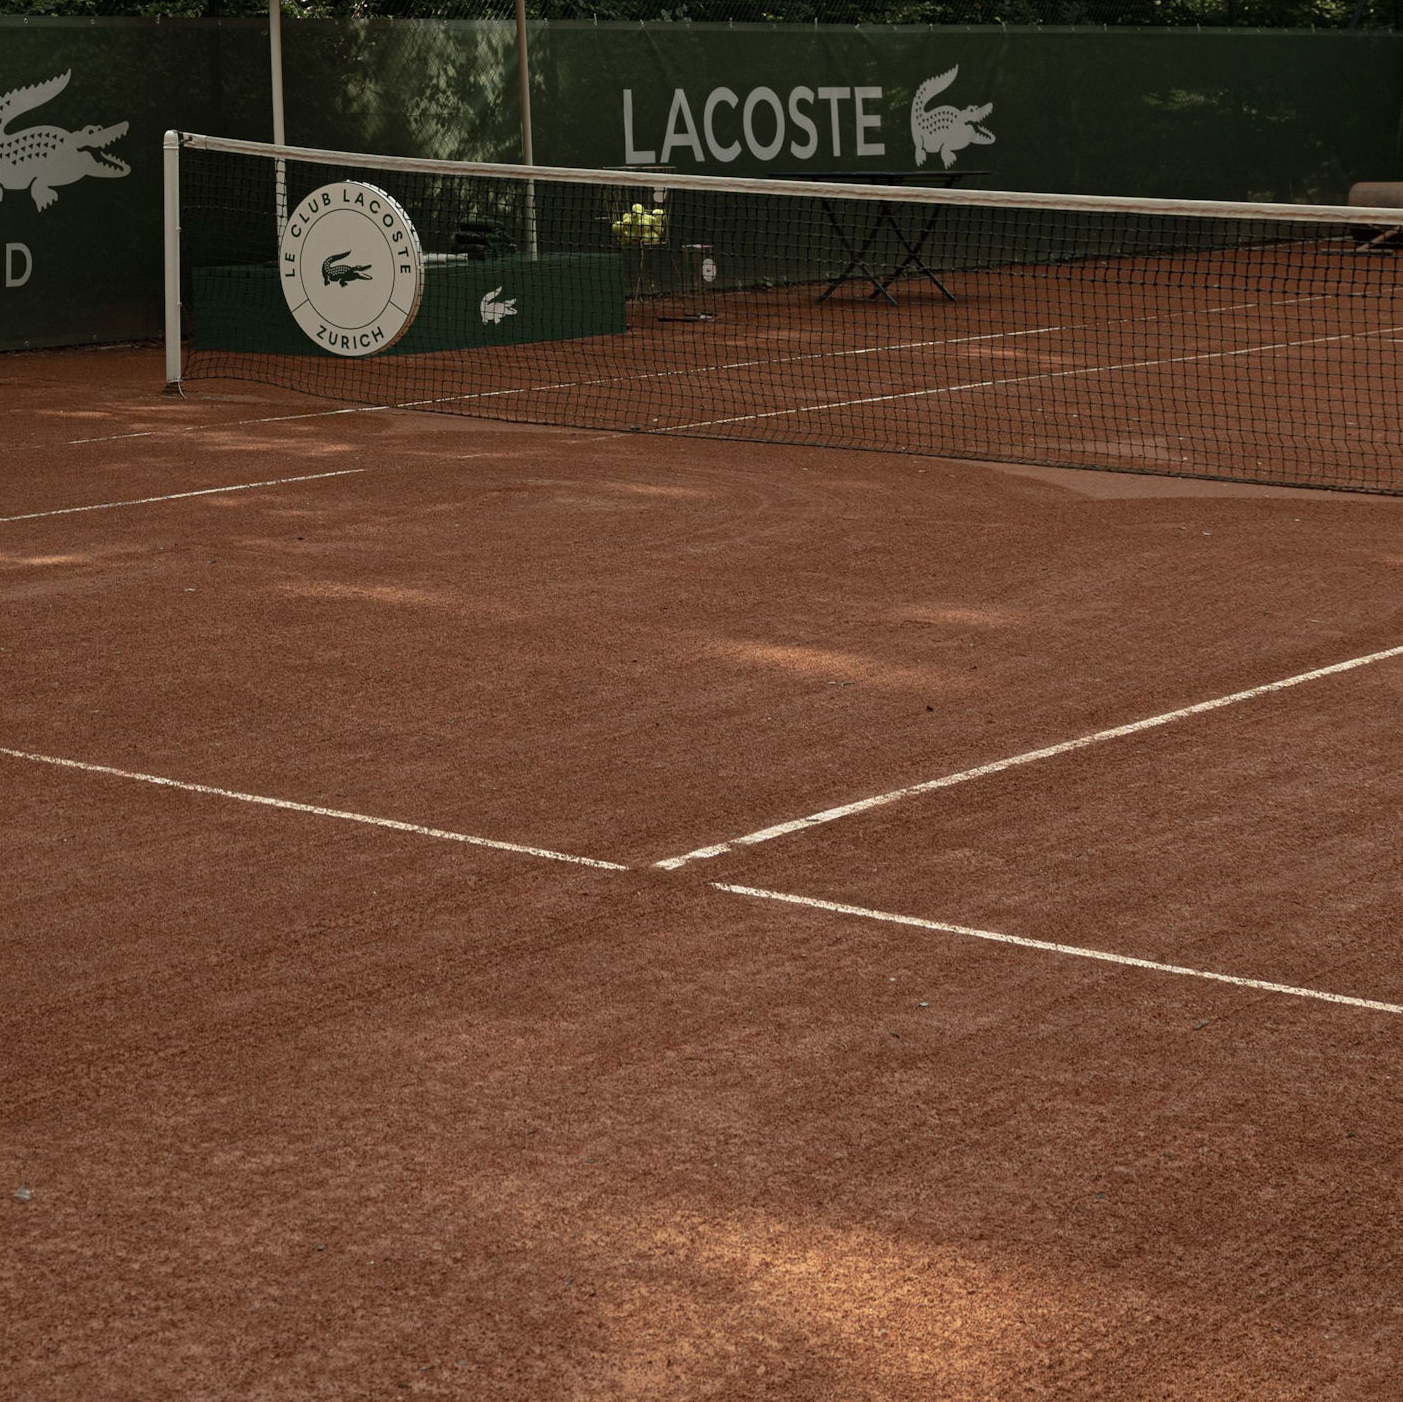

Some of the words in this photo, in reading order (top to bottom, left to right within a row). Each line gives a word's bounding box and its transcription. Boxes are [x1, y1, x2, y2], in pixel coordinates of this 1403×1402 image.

[622, 86, 886, 164] LACOSTE
[284, 252, 296, 278] LE
[290, 192, 332, 238] CLUB
[342, 188, 412, 275] LACOSTE
[316, 324, 385, 350] ZURICH
